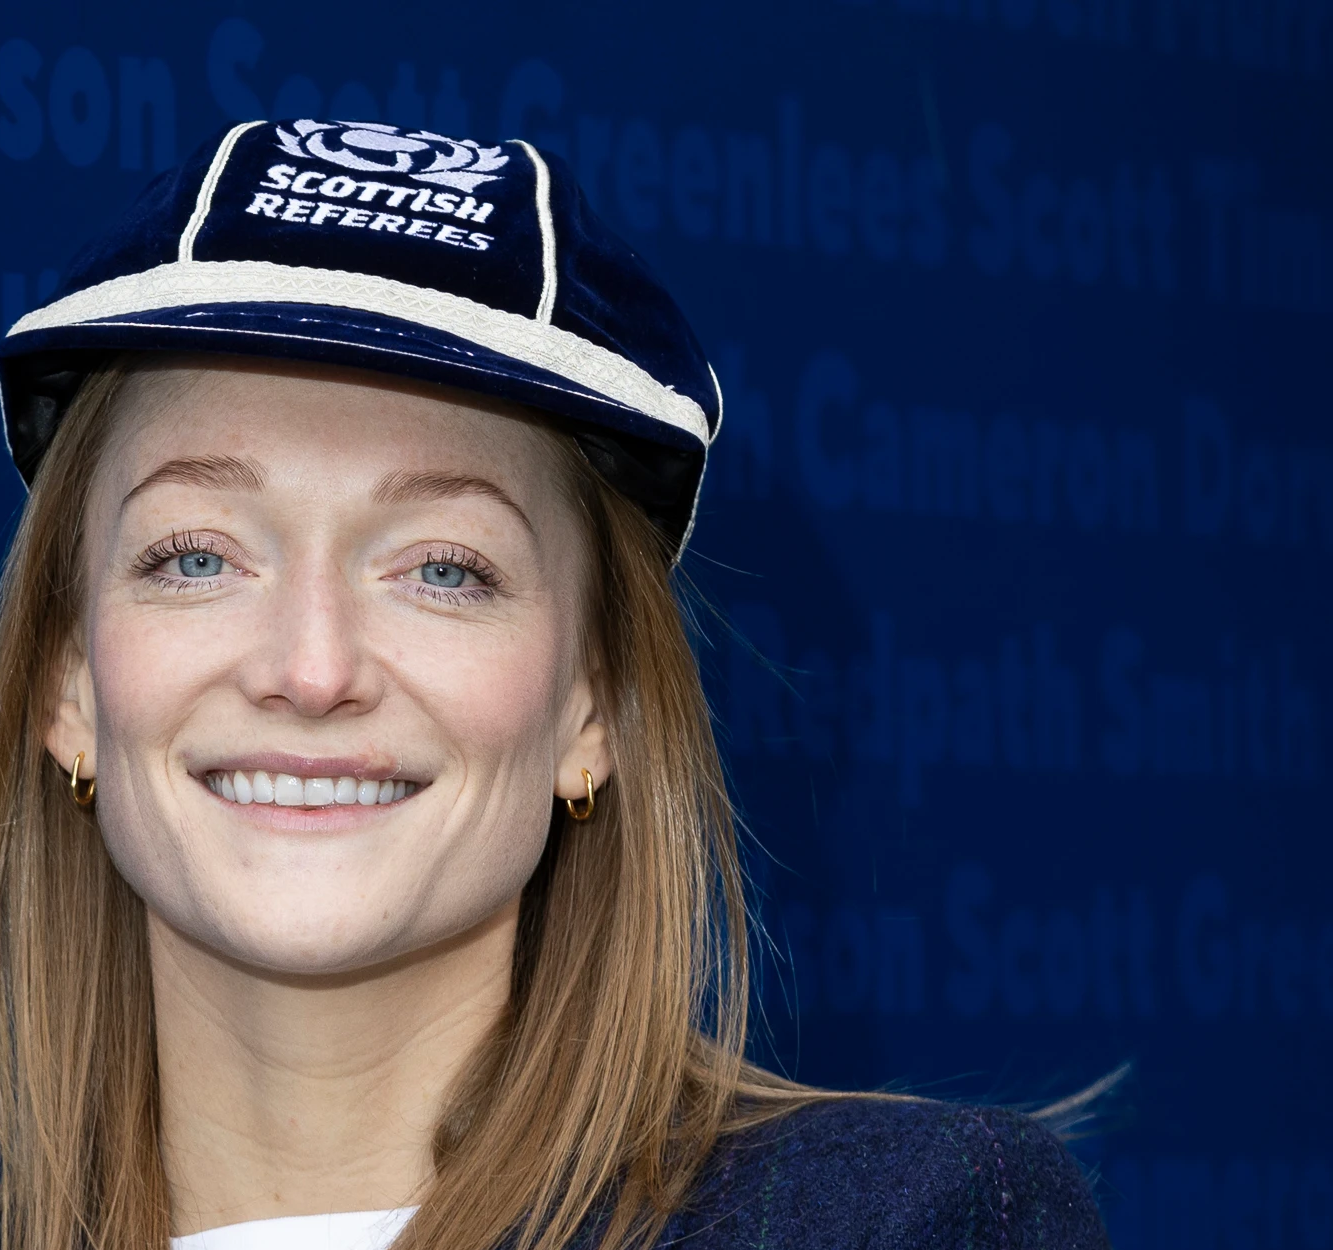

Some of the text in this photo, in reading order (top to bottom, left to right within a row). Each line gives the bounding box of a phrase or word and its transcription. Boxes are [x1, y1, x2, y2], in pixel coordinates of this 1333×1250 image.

[245, 192, 495, 252] REFEREES
[260, 164, 495, 224] SCOTTISH
[967, 120, 1178, 295] Scott
[1191, 152, 1333, 310] Tim
[796, 347, 1161, 535] Cameron
[1182, 393, 1333, 545] Dor
[1096, 620, 1321, 785] Smith
[943, 858, 1155, 1022] Scott
